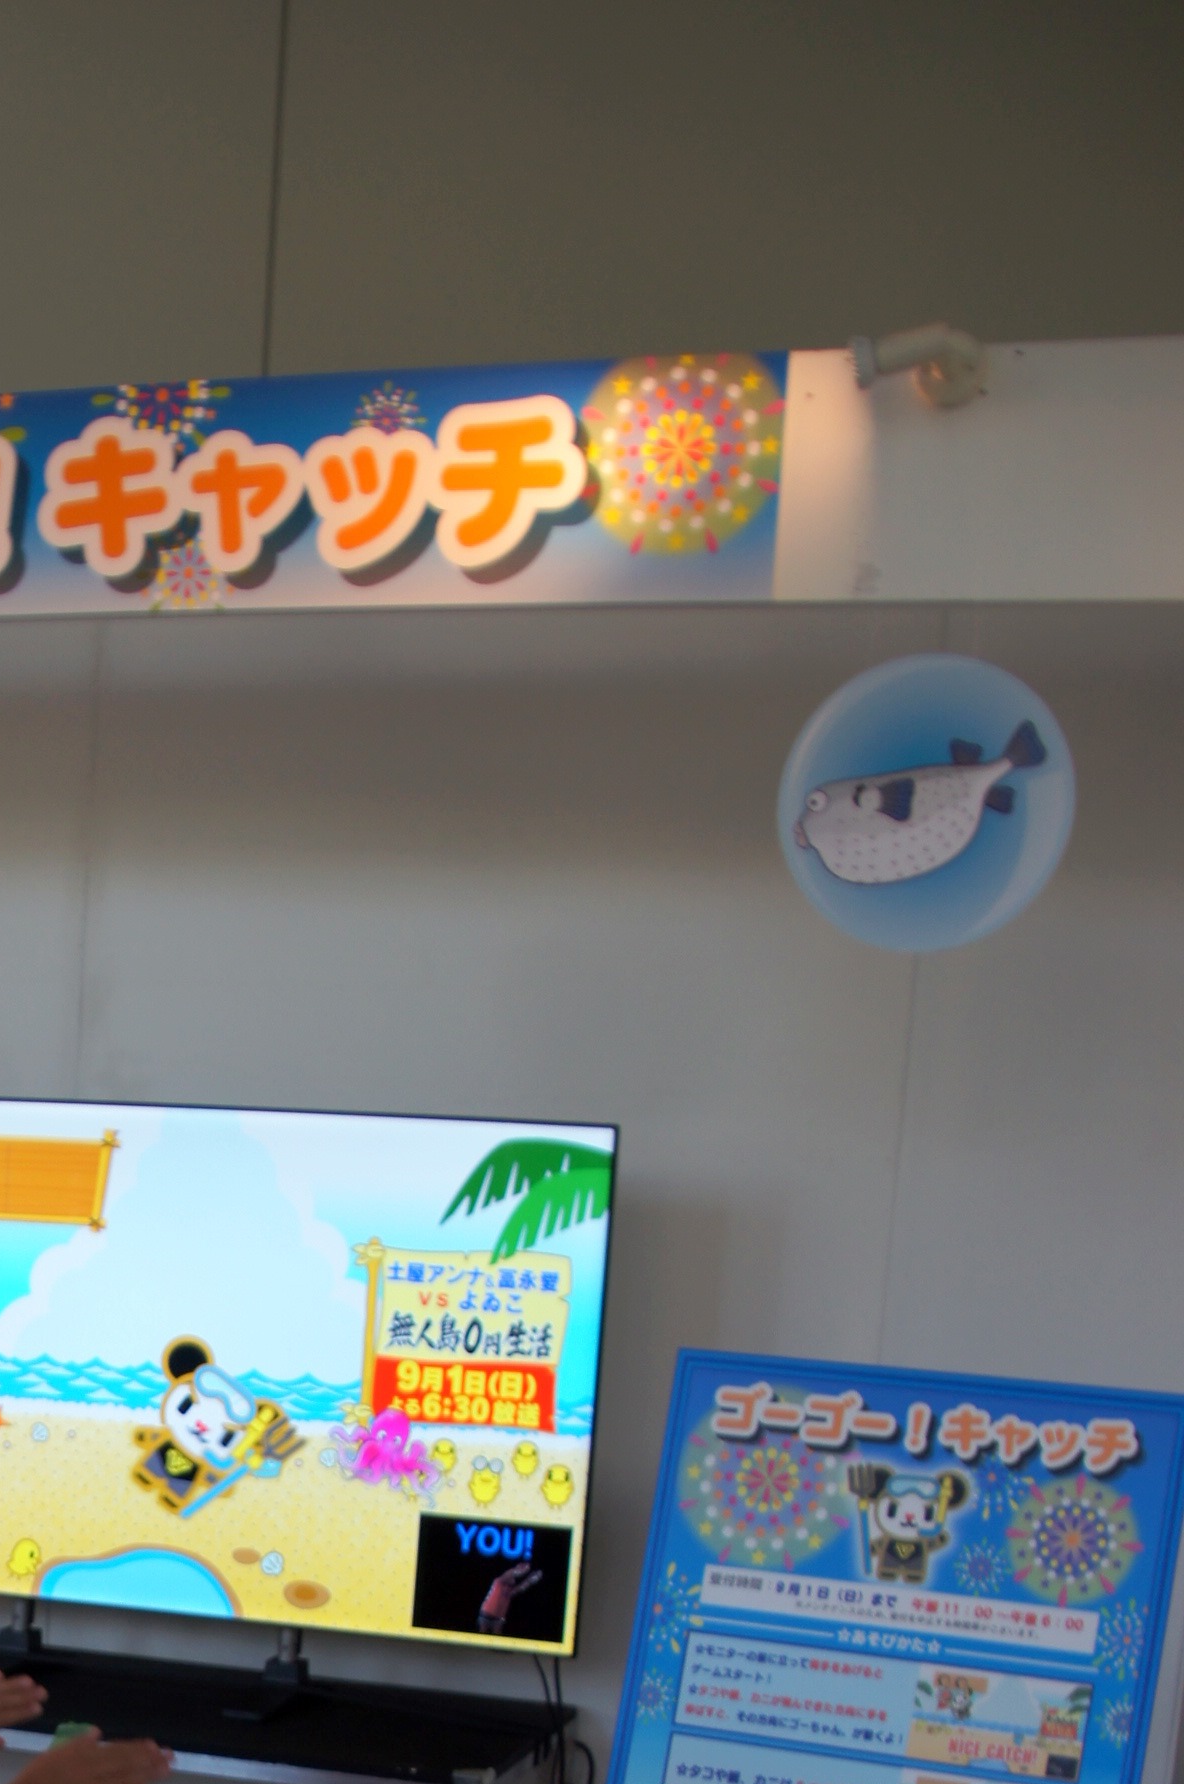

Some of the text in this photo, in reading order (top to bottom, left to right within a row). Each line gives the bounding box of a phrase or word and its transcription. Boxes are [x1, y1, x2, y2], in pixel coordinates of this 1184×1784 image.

[459, 1292, 523, 1313] よゐこ
[387, 1311, 552, 1357] 無人島0円生活
[396, 1360, 537, 1401] 9月1日(日)
[712, 1382, 1139, 1472] ゴーゴー！キャッチ
[456, 1522, 534, 1560] YOU!
